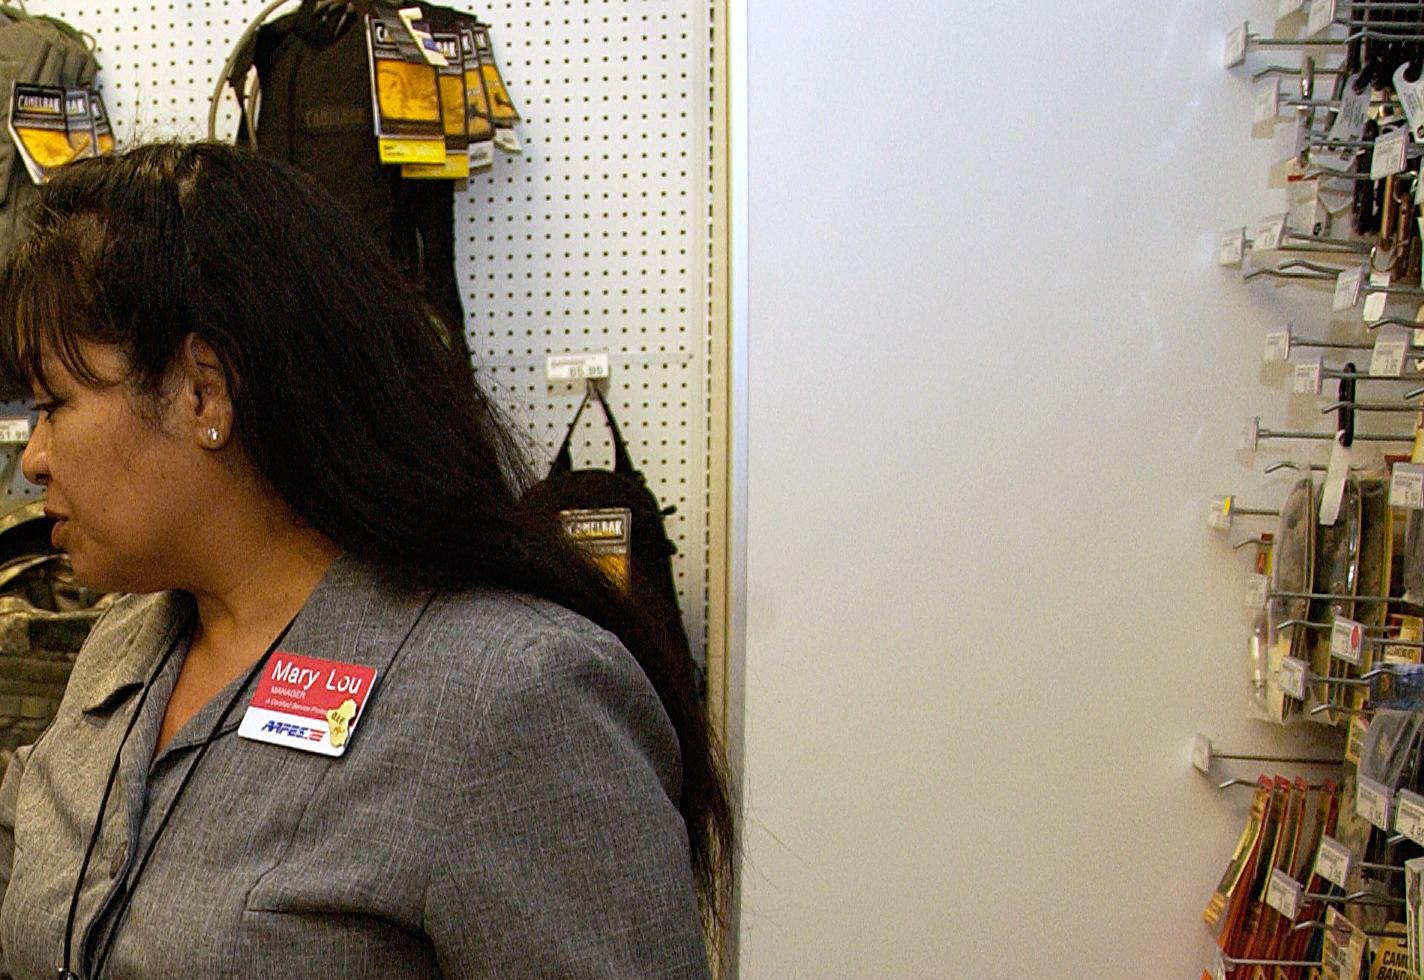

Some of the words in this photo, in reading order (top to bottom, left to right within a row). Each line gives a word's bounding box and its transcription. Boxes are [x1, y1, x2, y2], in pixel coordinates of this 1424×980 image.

[271, 659, 320, 691] Mary
[326, 668, 362, 694] Lou
[270, 686, 306, 700] MANAGER
[261, 720, 309, 739] AAFES
